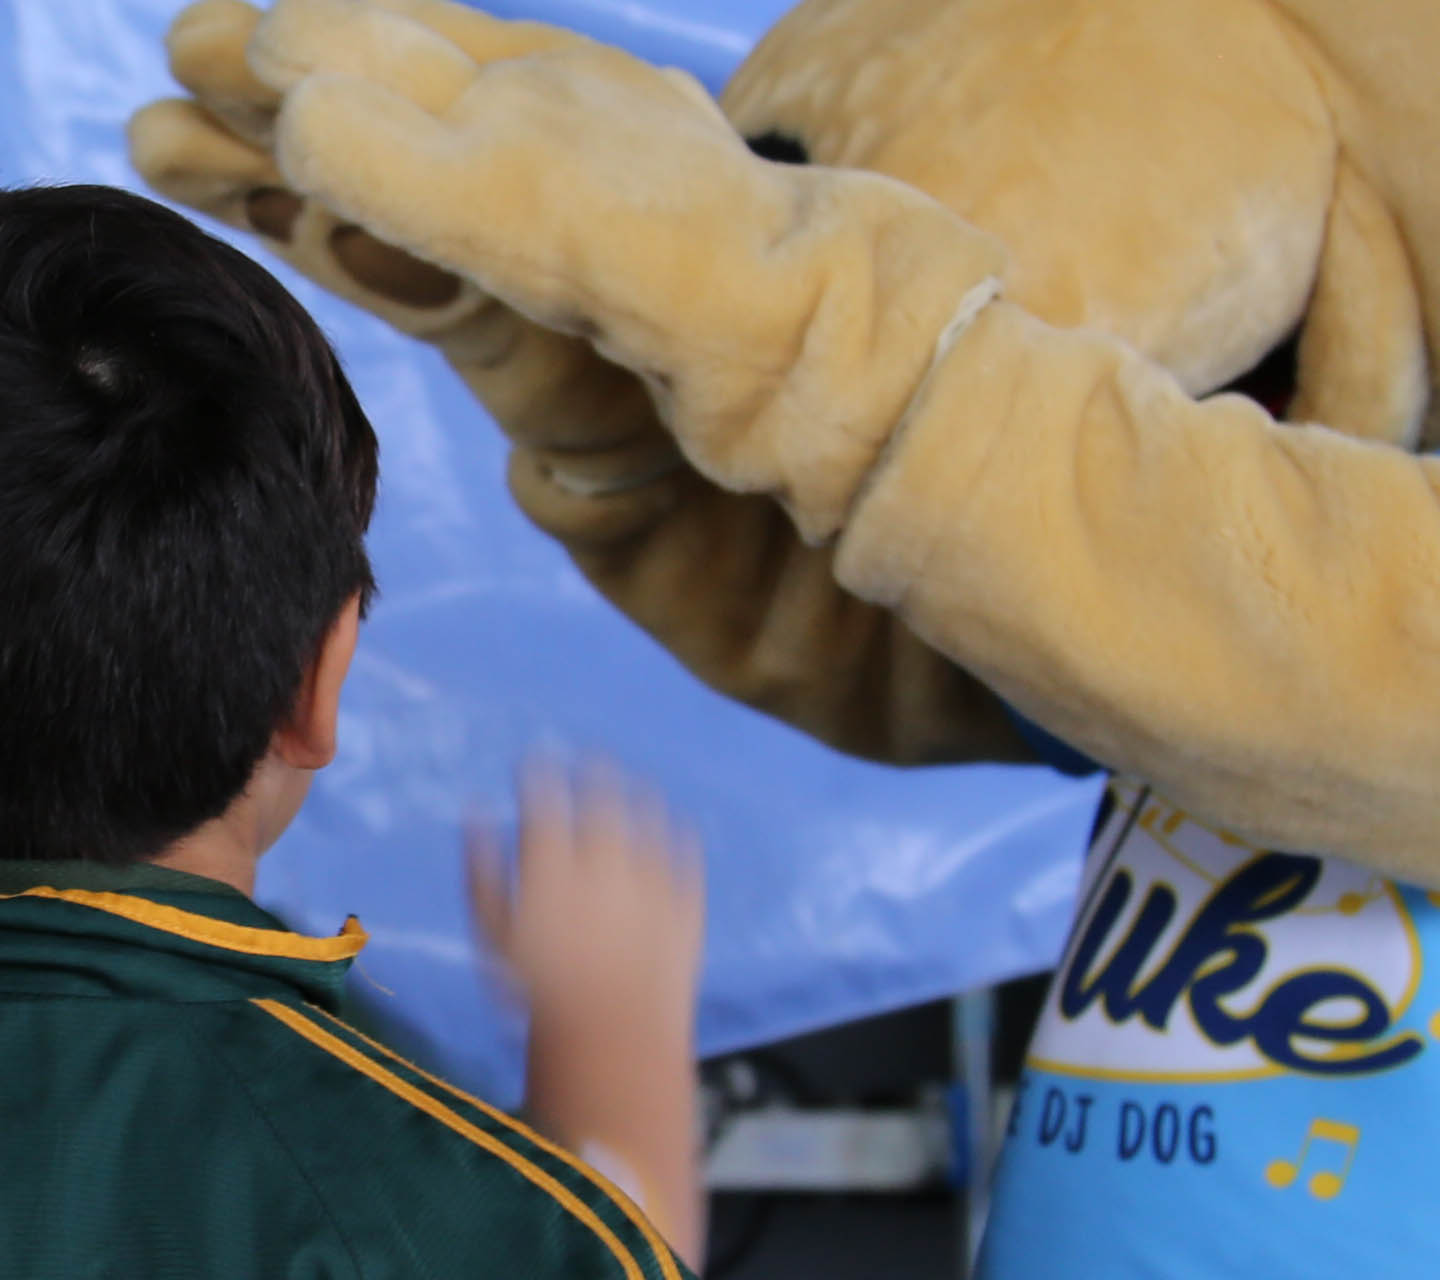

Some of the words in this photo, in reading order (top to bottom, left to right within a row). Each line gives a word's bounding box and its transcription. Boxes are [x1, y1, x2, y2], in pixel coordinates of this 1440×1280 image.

[1058, 790, 1425, 1078] uke
[1037, 1085, 1095, 1154] DJ
[1117, 1100, 1217, 1166] DOG
